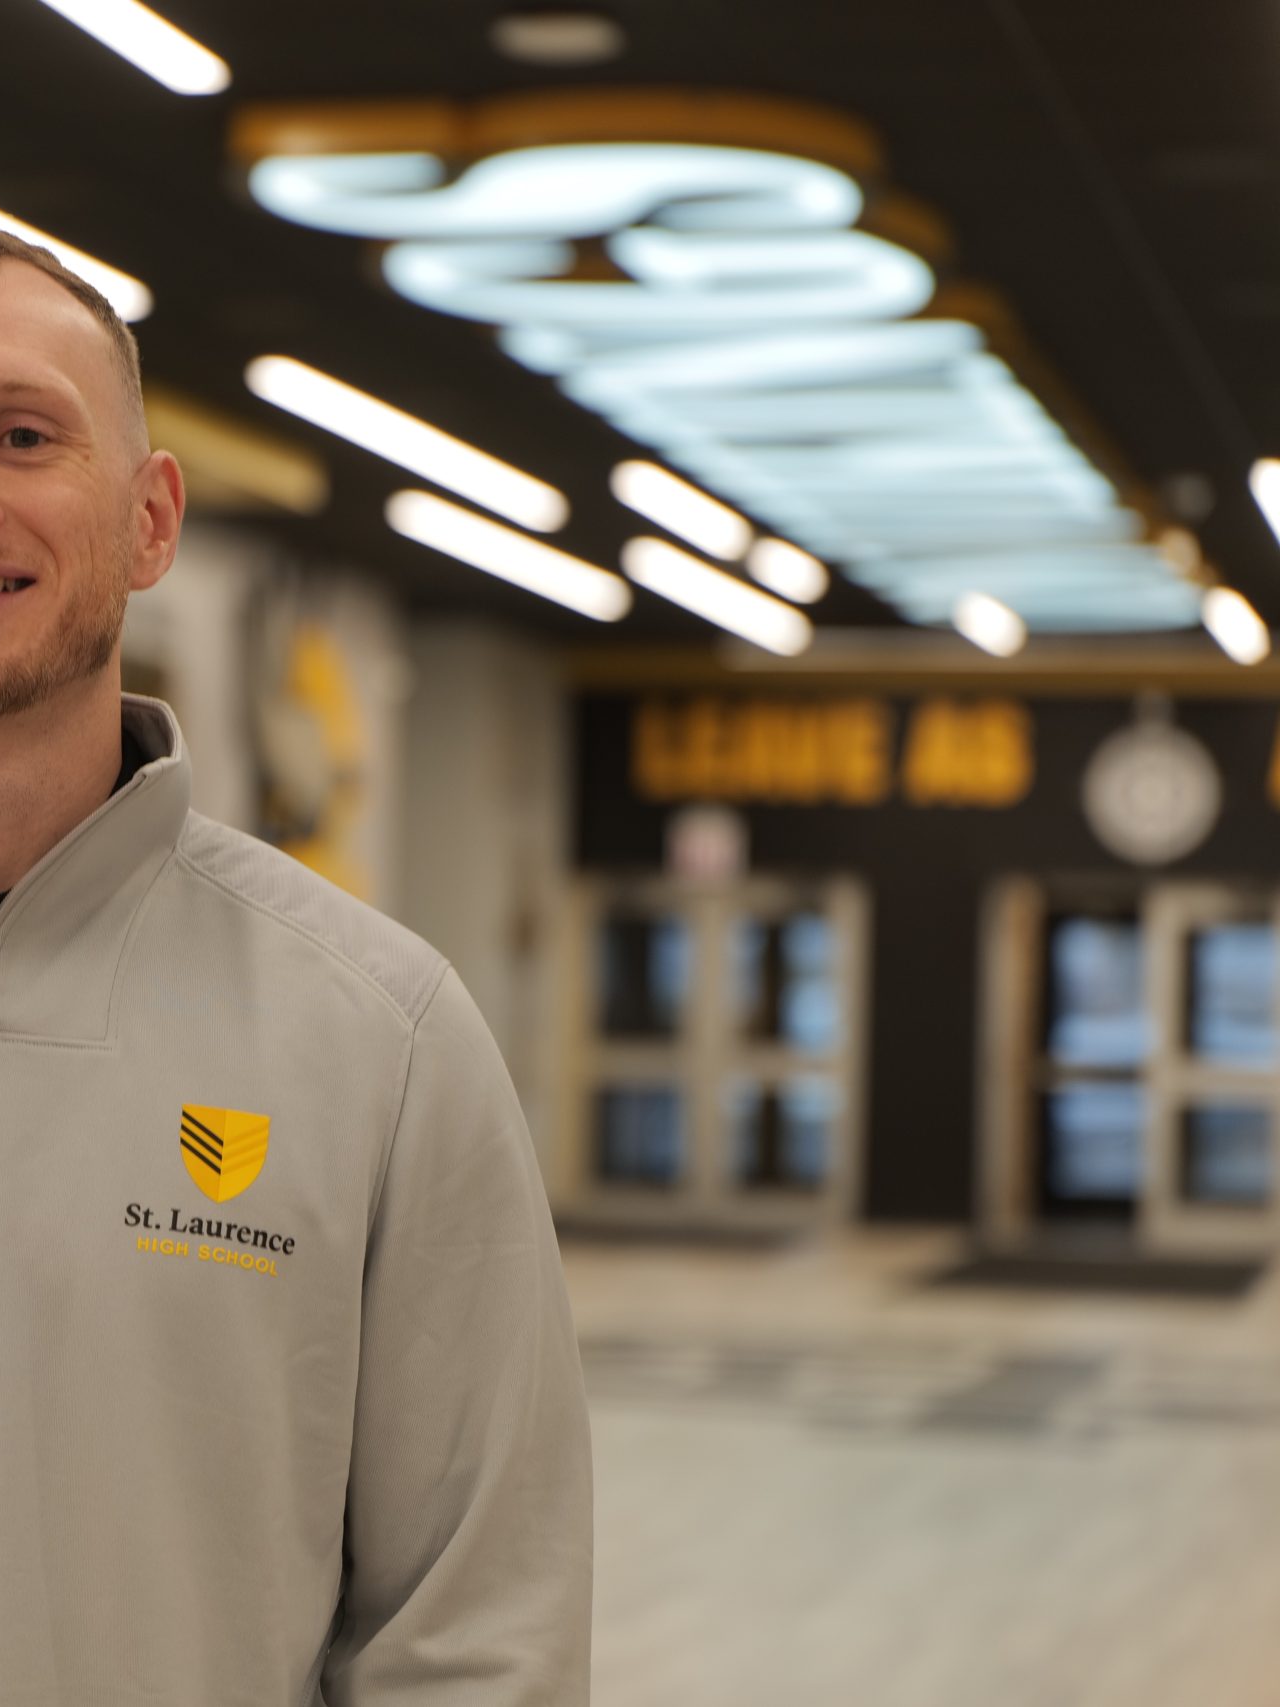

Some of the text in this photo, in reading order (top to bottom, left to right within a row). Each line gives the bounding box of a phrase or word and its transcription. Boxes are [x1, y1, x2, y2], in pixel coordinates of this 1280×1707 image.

[124, 1203, 296, 1255] St. Laurence
[136, 1236, 279, 1277] HIGH SCHOOL
